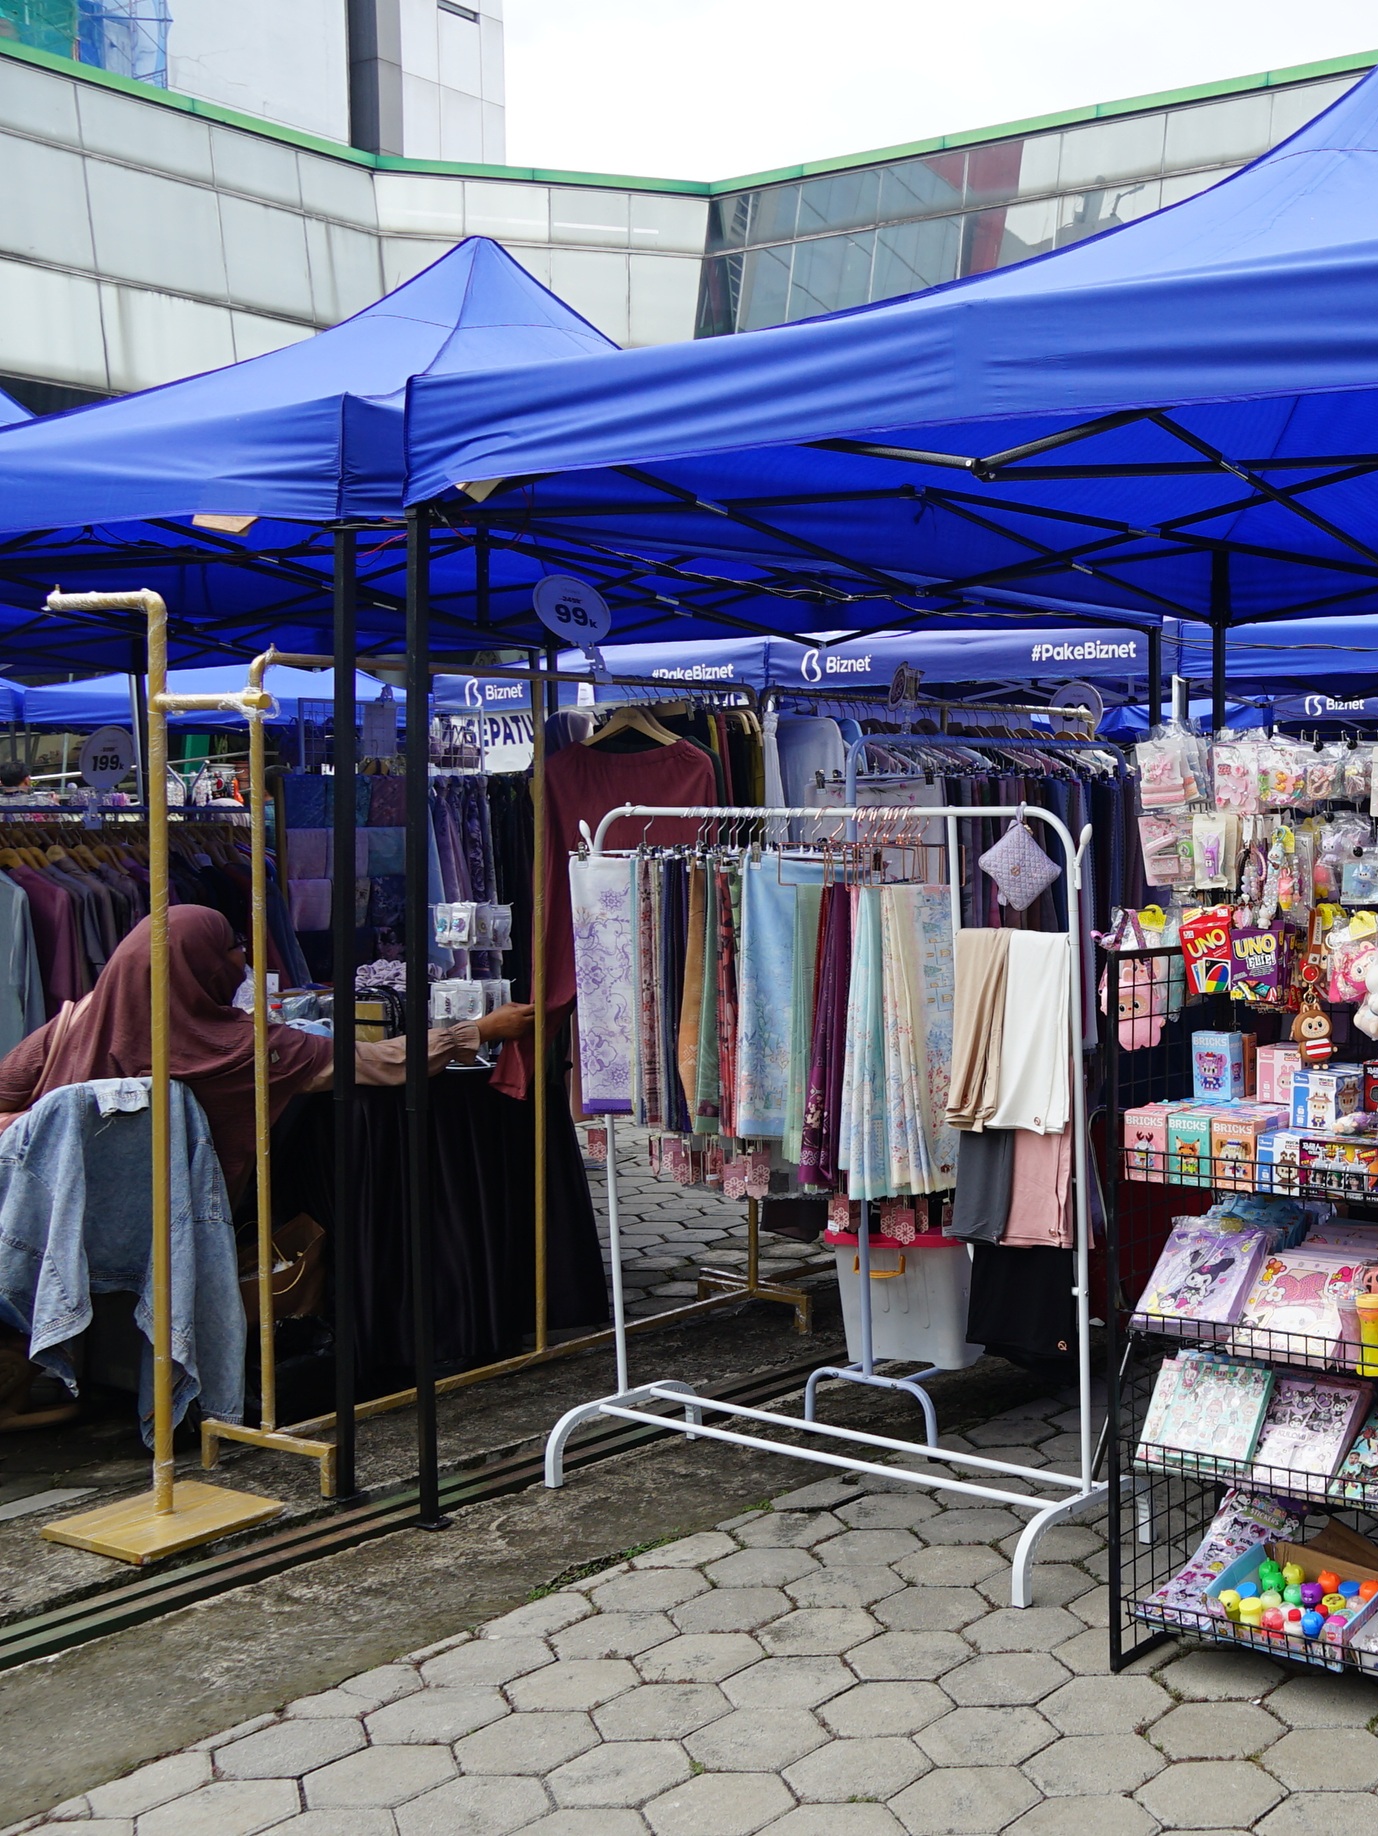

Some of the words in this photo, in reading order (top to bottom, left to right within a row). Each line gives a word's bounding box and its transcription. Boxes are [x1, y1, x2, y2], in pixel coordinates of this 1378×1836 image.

[1031, 640, 1136, 661] #PakeBiznet
[826, 655, 871, 673] Biznet
[485, 683, 523, 700] Biznet
[1326, 697, 1364, 710] Biznet
[1187, 929, 1226, 958] UNO
[1233, 934, 1277, 959] UNO
[1193, 1036, 1228, 1047] BRICKS
[1125, 1115, 1163, 1127] BRICKS
[1168, 1119, 1207, 1131] BRICKS
[1213, 1122, 1252, 1135] BRICKS
[1250, 1507, 1279, 1526] STICKERS
